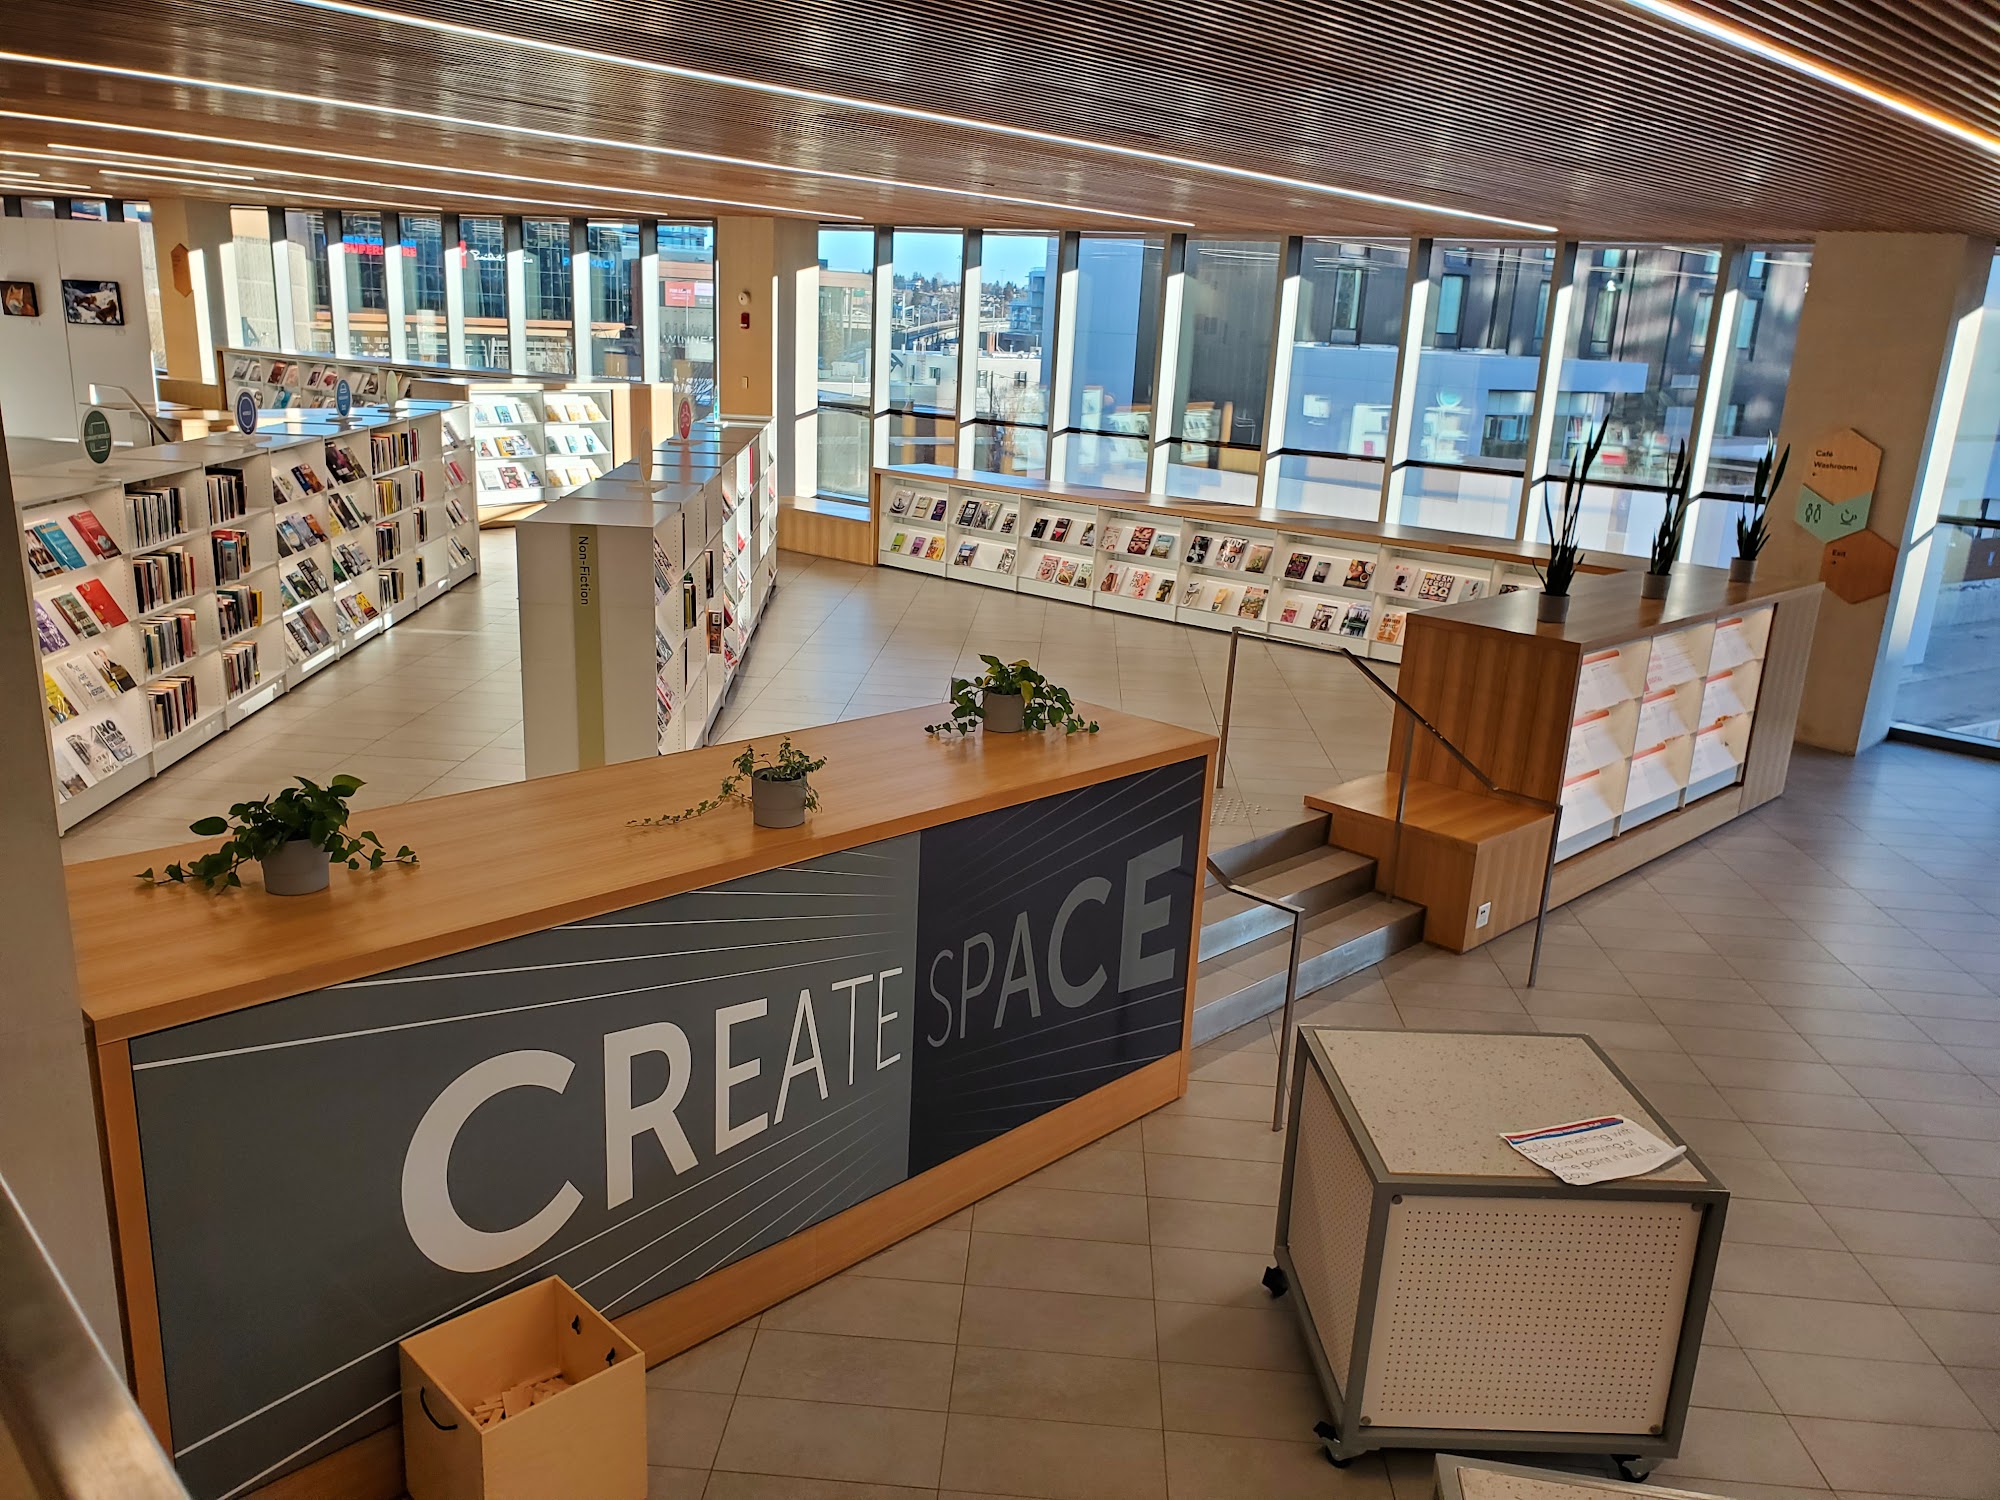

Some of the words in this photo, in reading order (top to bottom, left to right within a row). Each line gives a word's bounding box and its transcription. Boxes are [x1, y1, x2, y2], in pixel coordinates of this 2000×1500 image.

[663, 334, 714, 345] WINNE
[1815, 449, 1833, 457] Café
[1813, 461, 1858, 471] Washrooms
[1831, 549, 1846, 558] Exit
[578, 536, 591, 605] Non-Fiction
[1420, 585, 1449, 597] BBQ
[401, 967, 903, 1273] CREATE
[927, 835, 1184, 1047] SPACE
[1518, 1140, 1552, 1154] Build
[1569, 1142, 1625, 1157] knowing
